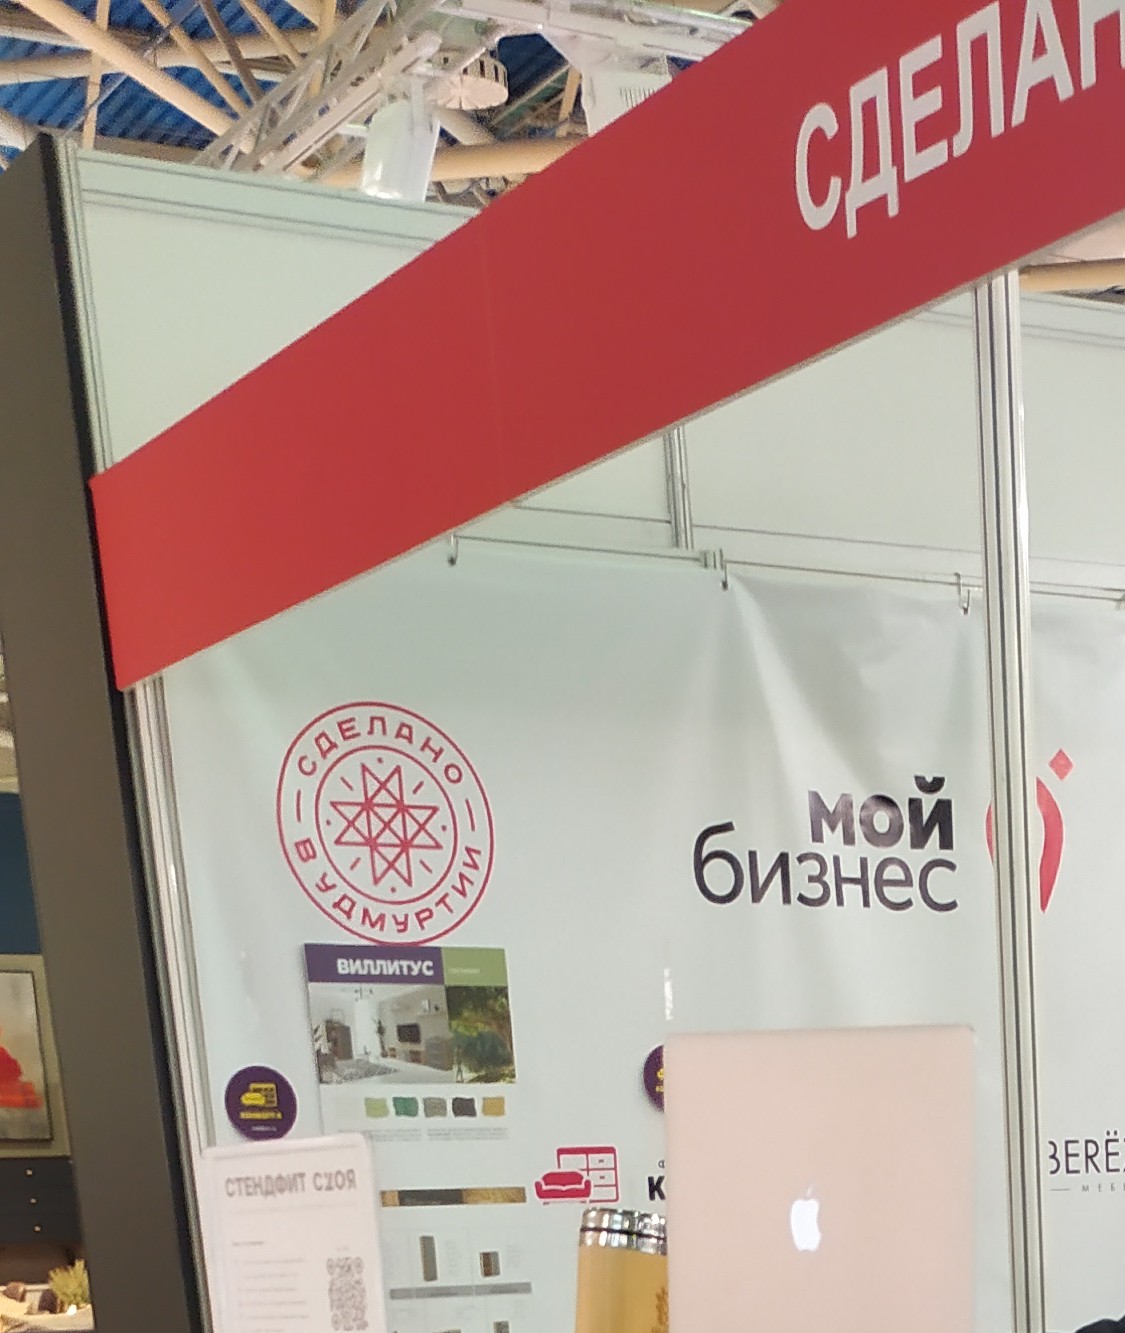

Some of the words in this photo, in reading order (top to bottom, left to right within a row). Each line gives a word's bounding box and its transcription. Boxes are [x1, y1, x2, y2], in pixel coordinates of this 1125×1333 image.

[297, 716, 463, 784] СДЕЛАНО
[294, 837, 318, 863] В
[315, 846, 482, 934] УДМУРТИИ
[692, 821, 959, 912] бизнес
[336, 957, 435, 977] ВИЛЛИТУС
[224, 1171, 307, 1199] СТЕНДФИТ
